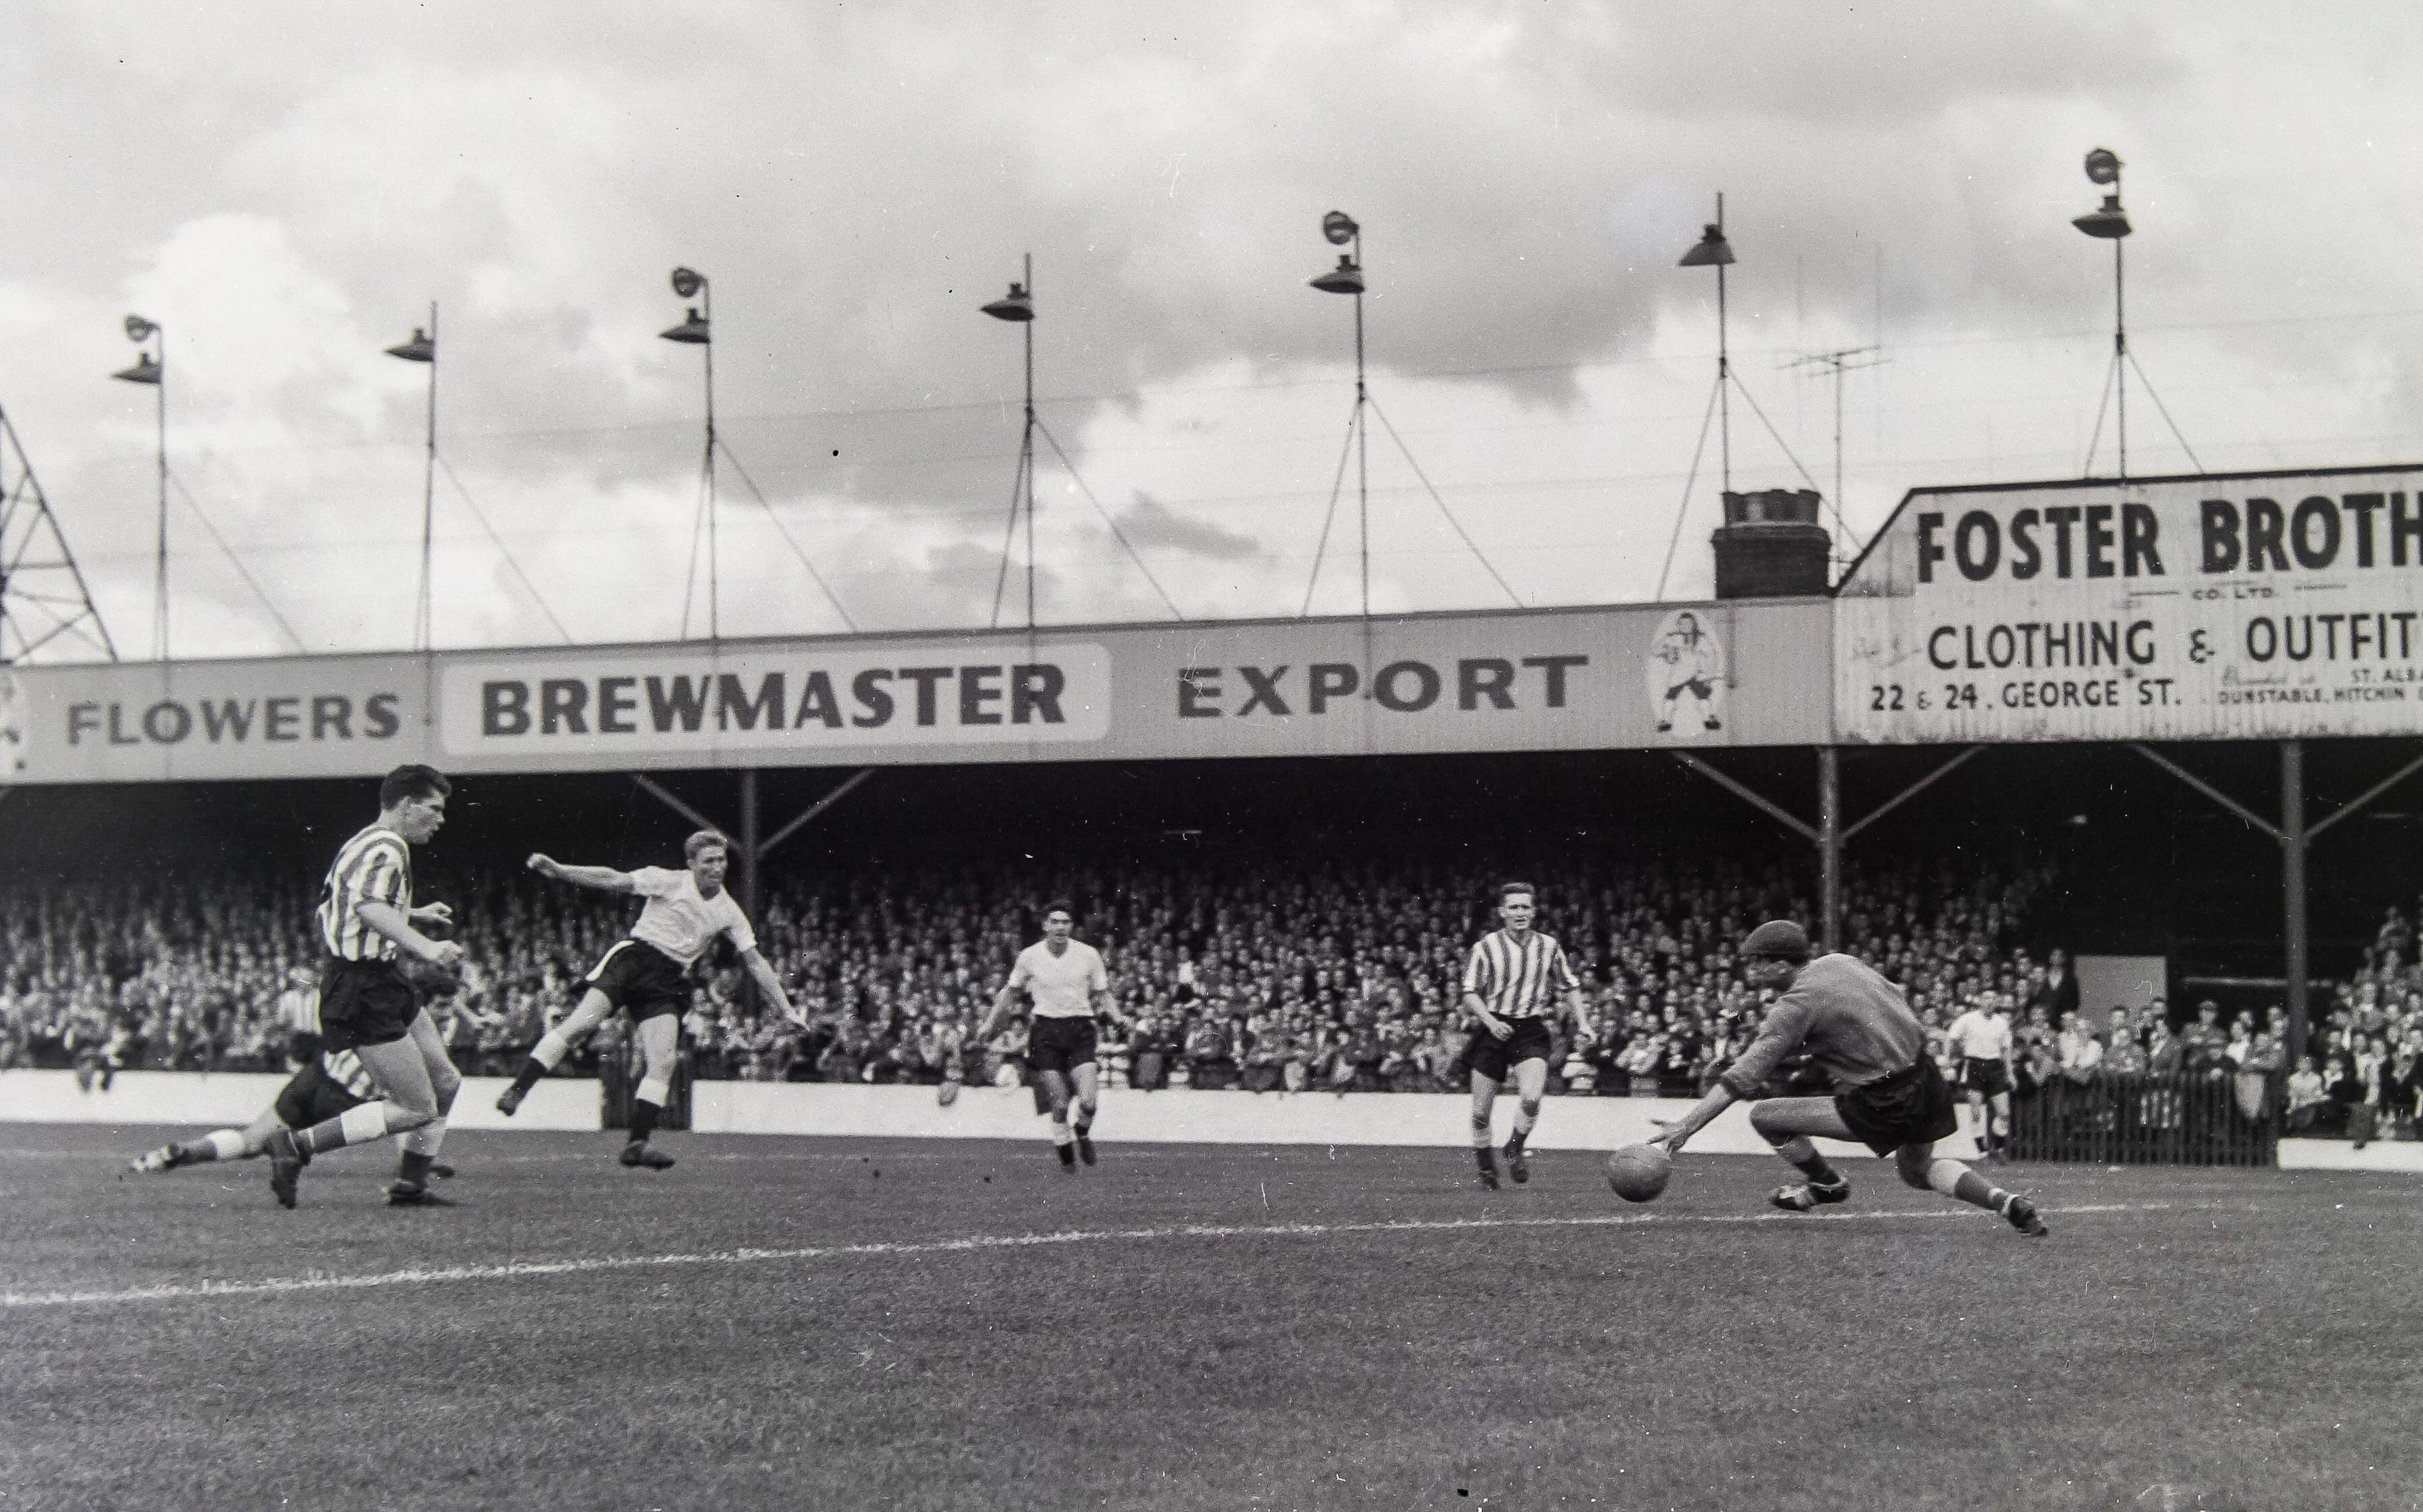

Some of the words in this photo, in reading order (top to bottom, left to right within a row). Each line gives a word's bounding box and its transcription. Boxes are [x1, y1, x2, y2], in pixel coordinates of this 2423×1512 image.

[1917, 503, 2166, 583] FOSTER
[2201, 492, 2423, 573] BROTH
[1928, 621, 2155, 668] CLOTHING
[2189, 629, 2215, 665] &
[2247, 612, 2418, 663] OUTFIT
[483, 663, 1065, 736] BREWMASTER
[1177, 655, 1589, 718] EXPORT
[1871, 684, 1904, 711] 22
[1916, 690, 1932, 710] &
[2002, 679, 2119, 709] GEORGE
[2138, 678, 2182, 706] ST.
[68, 692, 400, 745] FLOWERS
